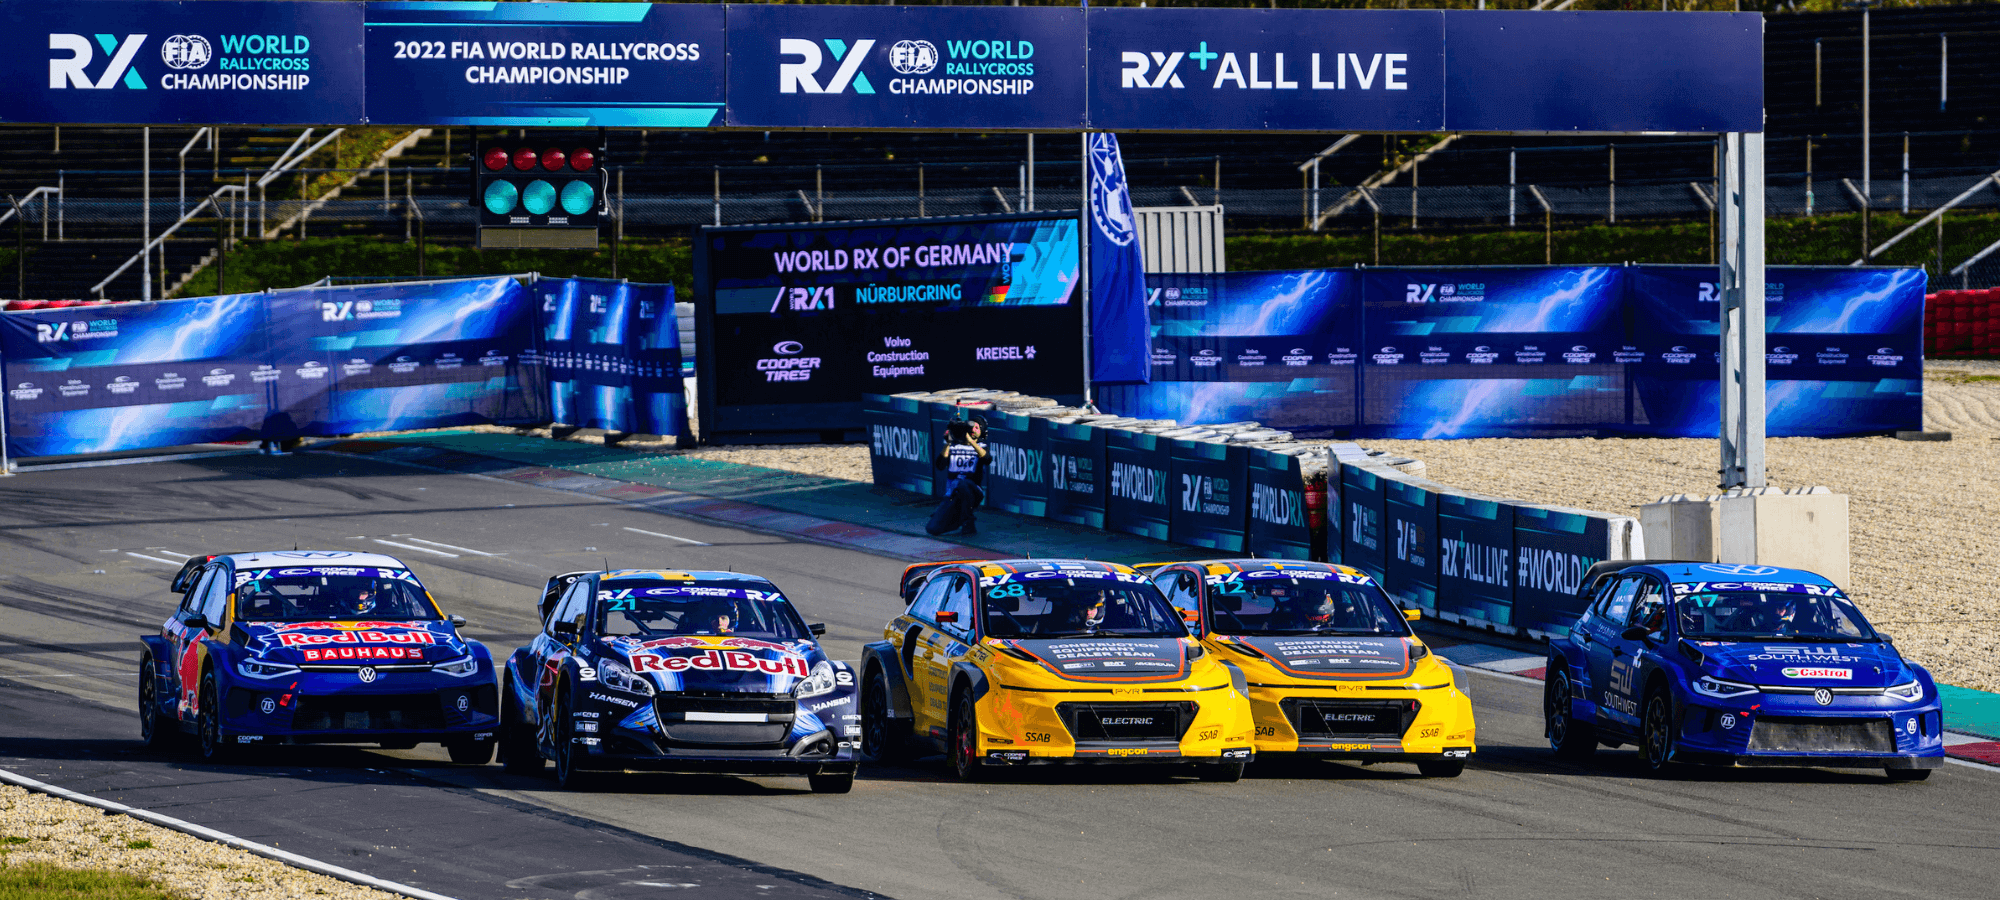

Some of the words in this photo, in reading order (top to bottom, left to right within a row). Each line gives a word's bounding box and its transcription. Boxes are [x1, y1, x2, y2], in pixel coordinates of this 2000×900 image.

[220, 34, 310, 54] WORLD
[946, 40, 1034, 59] WORLD
[394, 42, 446, 59] 2022
[451, 42, 485, 60] FIA
[488, 42, 566, 60] WORLD
[571, 43, 700, 61] RALLYCROSS
[49, 33, 147, 89] RX
[220, 57, 310, 71] RALLYCROSS
[780, 39, 876, 94] RX
[465, 66, 629, 84] CHAMPIONSHIP
[946, 62, 1034, 76] RALLYCROSS
[1312, 53, 1408, 90] LIVE
[161, 74, 310, 90] CHAMPIONSHIP
[889, 79, 1034, 95] CHAMPIONSHIP
[774, 250, 849, 273] WORLD
[853, 248, 879, 270] RX
[883, 247, 909, 268] OF
[915, 243, 1014, 267] GERMANY
[794, 286, 835, 310] RX1
[856, 283, 961, 303] NÜRBURGRING
[1406, 284, 1436, 302] RX
[322, 301, 354, 321] RX
[89, 319, 117, 327] WORLD
[37, 322, 69, 342] RX
[884, 336, 911, 348] Volvo
[867, 350, 929, 363] Construction
[976, 346, 1023, 360] KREISEL
[756, 357, 821, 371] COOPER
[873, 364, 924, 378] Equipment
[766, 369, 811, 382] TIRES
[873, 424, 930, 463] #WORLDRX
[990, 442, 1043, 483] #WORLDRX
[1052, 454, 1068, 490] RX
[1112, 462, 1167, 506] #WORLDRX
[1182, 473, 1202, 512] RX
[1252, 483, 1305, 528] #WORLDRX
[1485, 546, 1508, 587] LIVE
[236, 569, 274, 583] RX
[377, 568, 415, 581] RX
[980, 573, 1017, 587] RX
[1114, 571, 1154, 585] RX
[1205, 572, 1244, 585] RX
[1337, 572, 1376, 586] RX
[598, 588, 633, 600] RX
[989, 583, 1026, 599] 68
[1213, 580, 1246, 595] 12
[1672, 582, 1710, 593] RX
[1804, 584, 1843, 597] RX
[745, 589, 785, 602] RX
[1690, 594, 1719, 607] 17
[608, 598, 636, 611] 21
[277, 631, 359, 646] Red
[360, 631, 436, 645] Bull
[306, 648, 421, 660] BAUHAUS
[630, 650, 723, 673] Red
[724, 651, 811, 678] Bull
[1800, 668, 1848, 678] Castrol
[589, 692, 638, 708] HANSEN
[811, 696, 851, 711] HANSEN
[1102, 717, 1153, 725] ELECTRIC
[1324, 713, 1376, 722] ELECTRIC
[1025, 732, 1051, 743] SSAB
[1199, 729, 1219, 742] SSAB
[1420, 728, 1439, 738] SSAB
[1107, 748, 1148, 757] engcon
[1331, 742, 1371, 751] engcon
